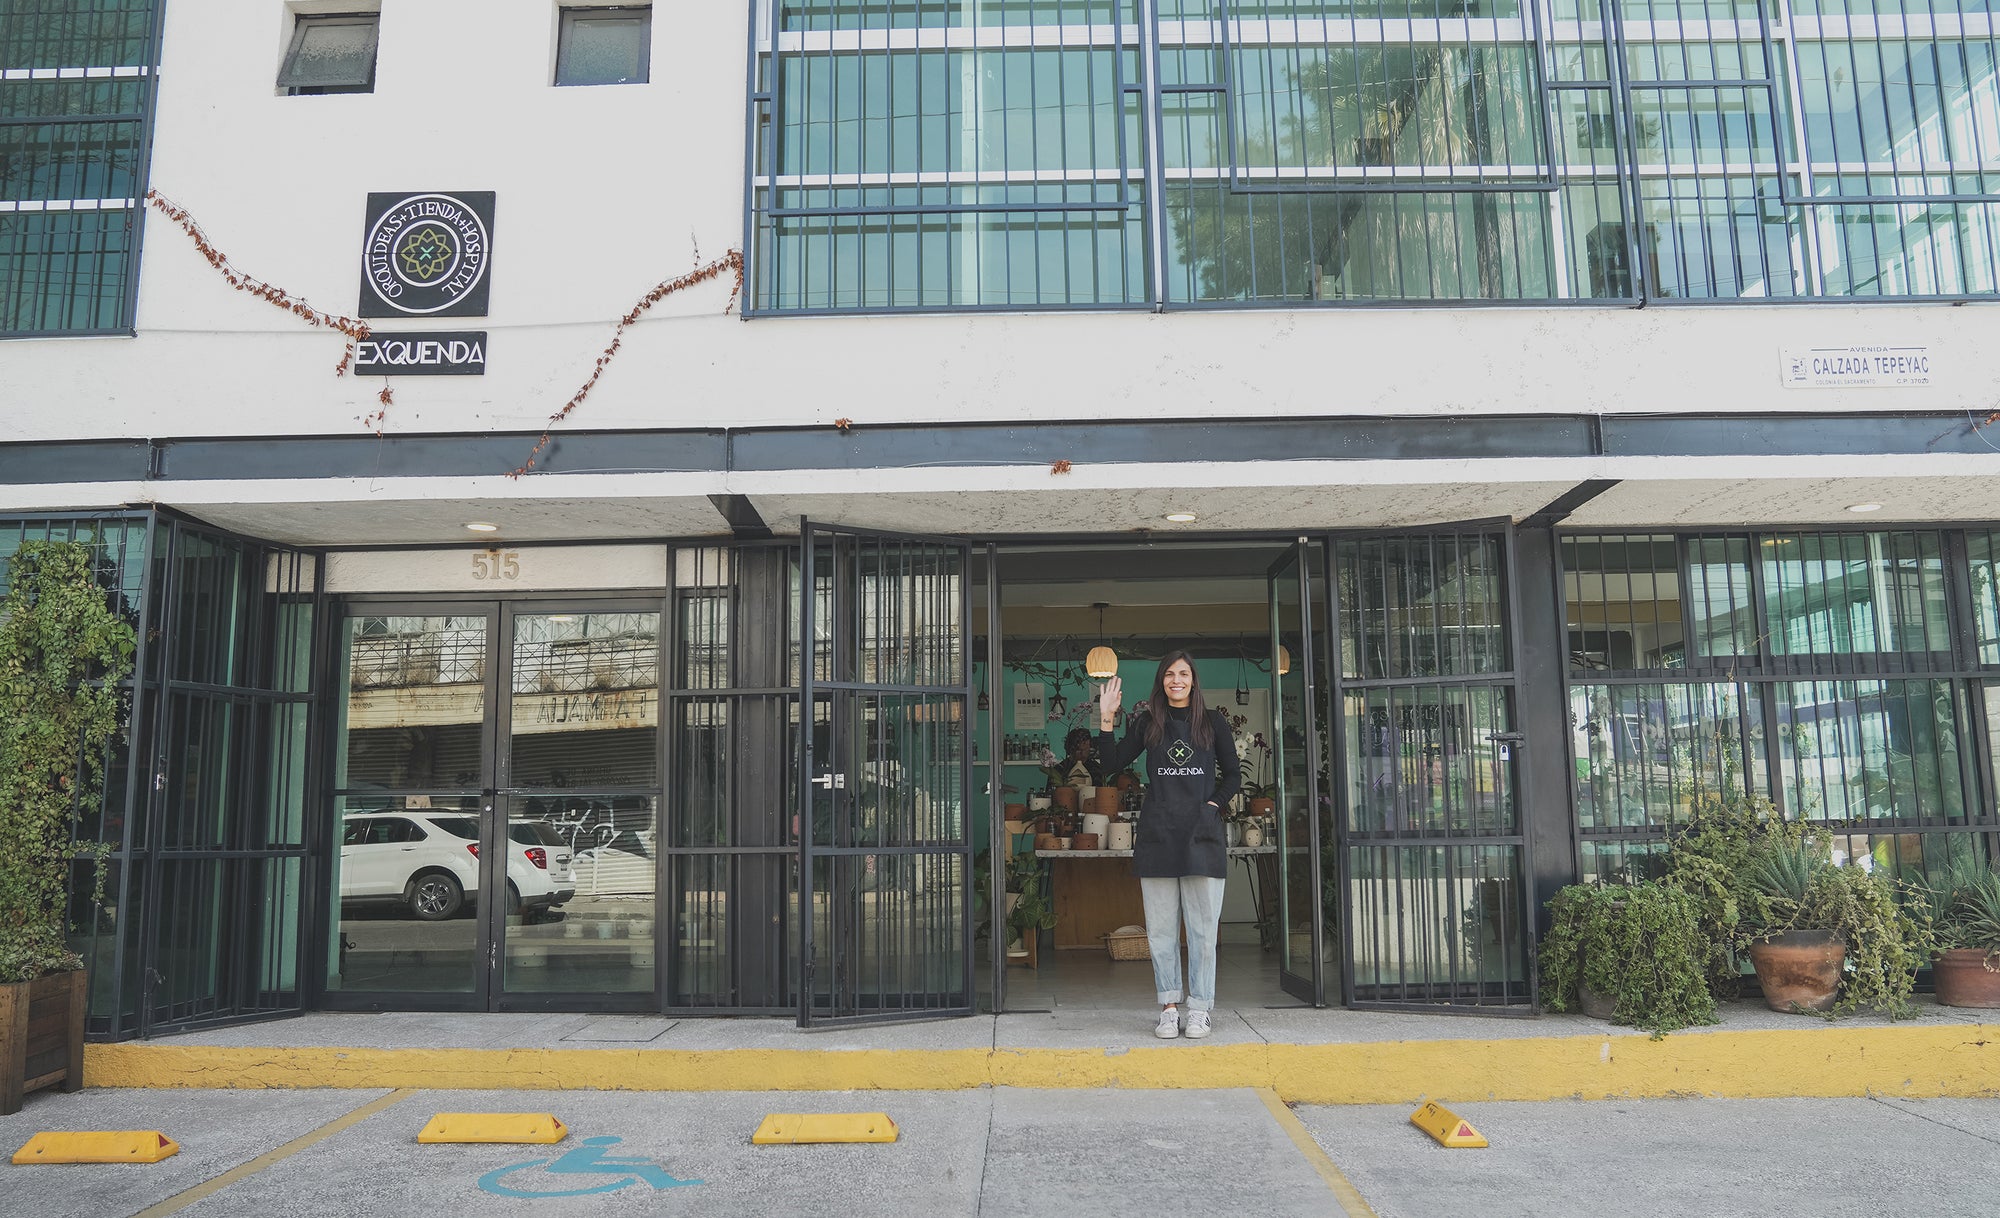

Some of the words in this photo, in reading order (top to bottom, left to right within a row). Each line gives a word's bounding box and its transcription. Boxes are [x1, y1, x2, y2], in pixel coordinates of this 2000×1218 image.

[1813, 357, 1870, 375] CALZADA
[1874, 356, 1929, 374] TEPEYAC
[472, 553, 520, 580] 515
[1157, 767, 1205, 776] EXQUENDA
